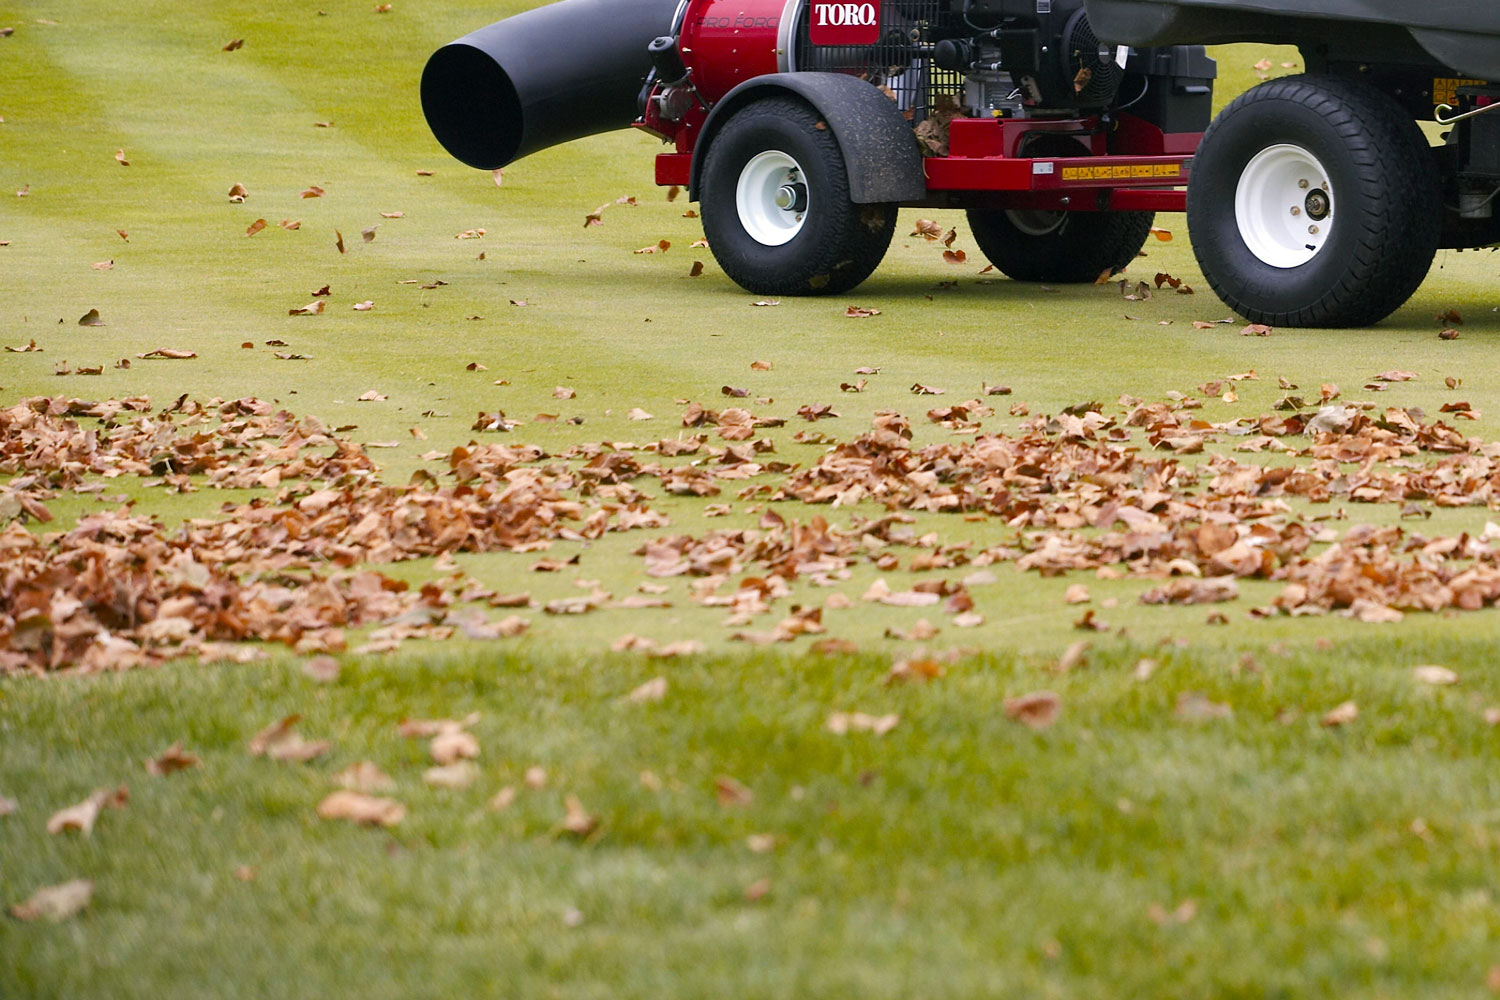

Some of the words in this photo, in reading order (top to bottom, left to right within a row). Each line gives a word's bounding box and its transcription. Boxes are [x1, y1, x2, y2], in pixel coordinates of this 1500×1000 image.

[696, 17, 730, 28] PRO
[734, 17, 780, 28] FORC
[815, 3, 876, 26] TORO
